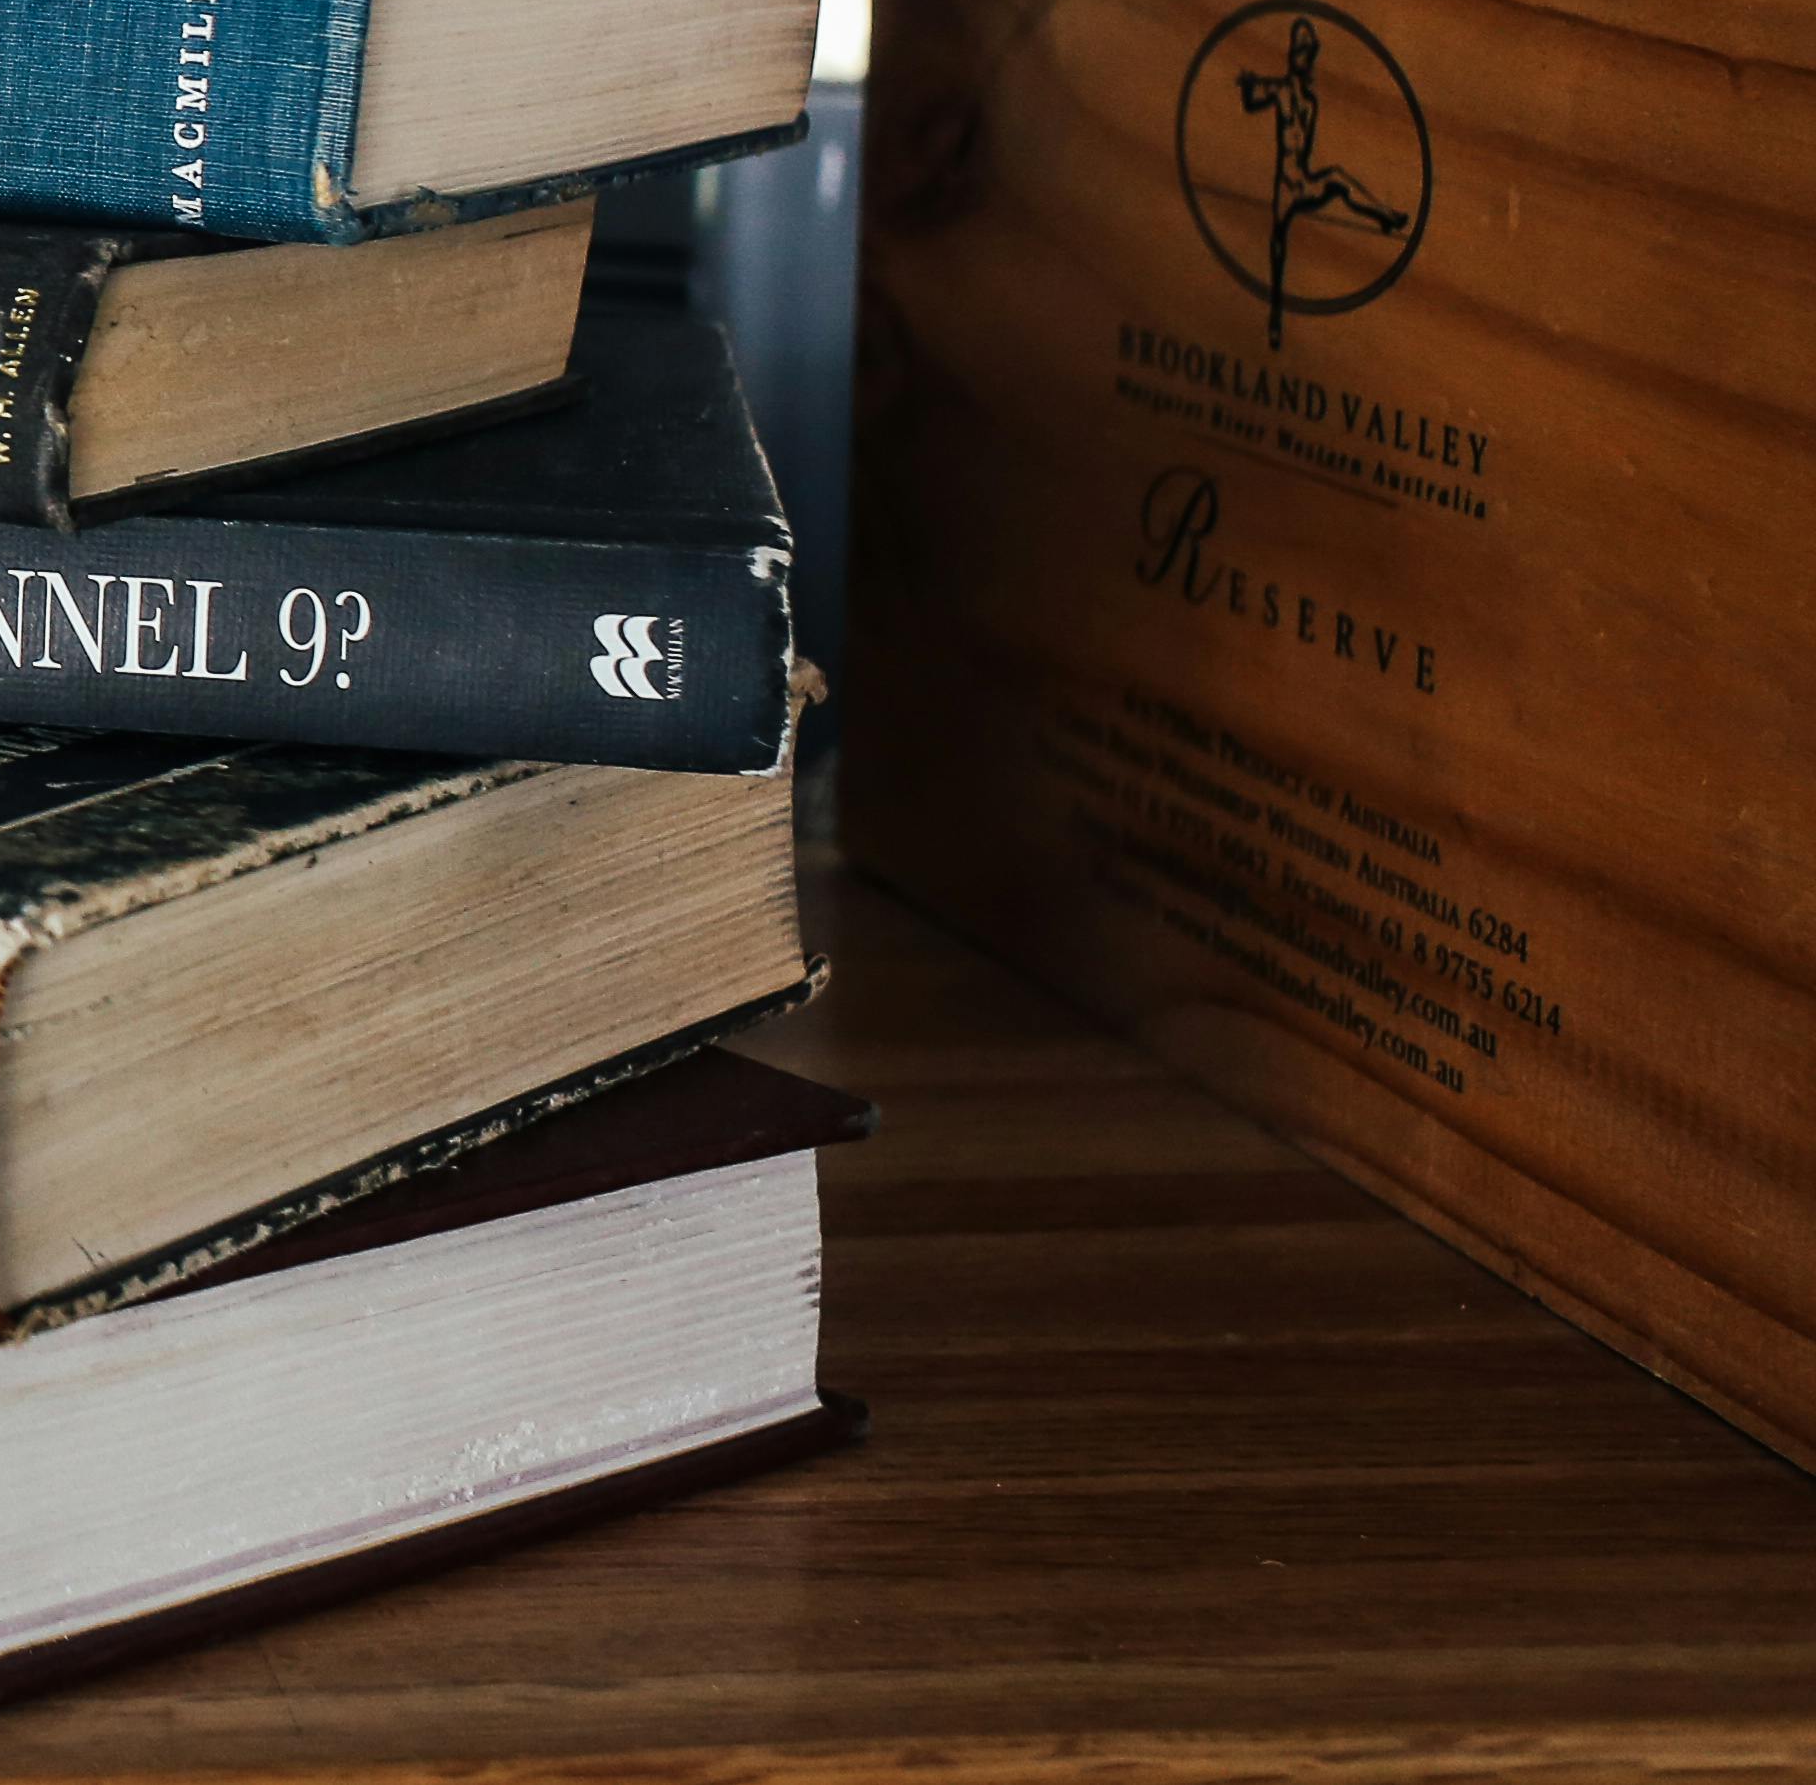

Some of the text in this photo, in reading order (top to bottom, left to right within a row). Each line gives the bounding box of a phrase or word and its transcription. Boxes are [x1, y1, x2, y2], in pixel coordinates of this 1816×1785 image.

[1117, 320, 1489, 477] BROOKLAND VALLEY
[1276, 428, 1362, 476] Western
[1372, 461, 1488, 522] Australia
[1136, 466, 1438, 696] RESERVE
[278, 588, 371, 689] 9?
[666, 617, 684, 699] MACMILLAN
[1380, 916, 1404, 954] 61
[1414, 931, 1429, 966] 8
[1436, 944, 1495, 1003] 9755
[1504, 980, 1562, 1036] 6214
[1468, 906, 1528, 963] 6284
